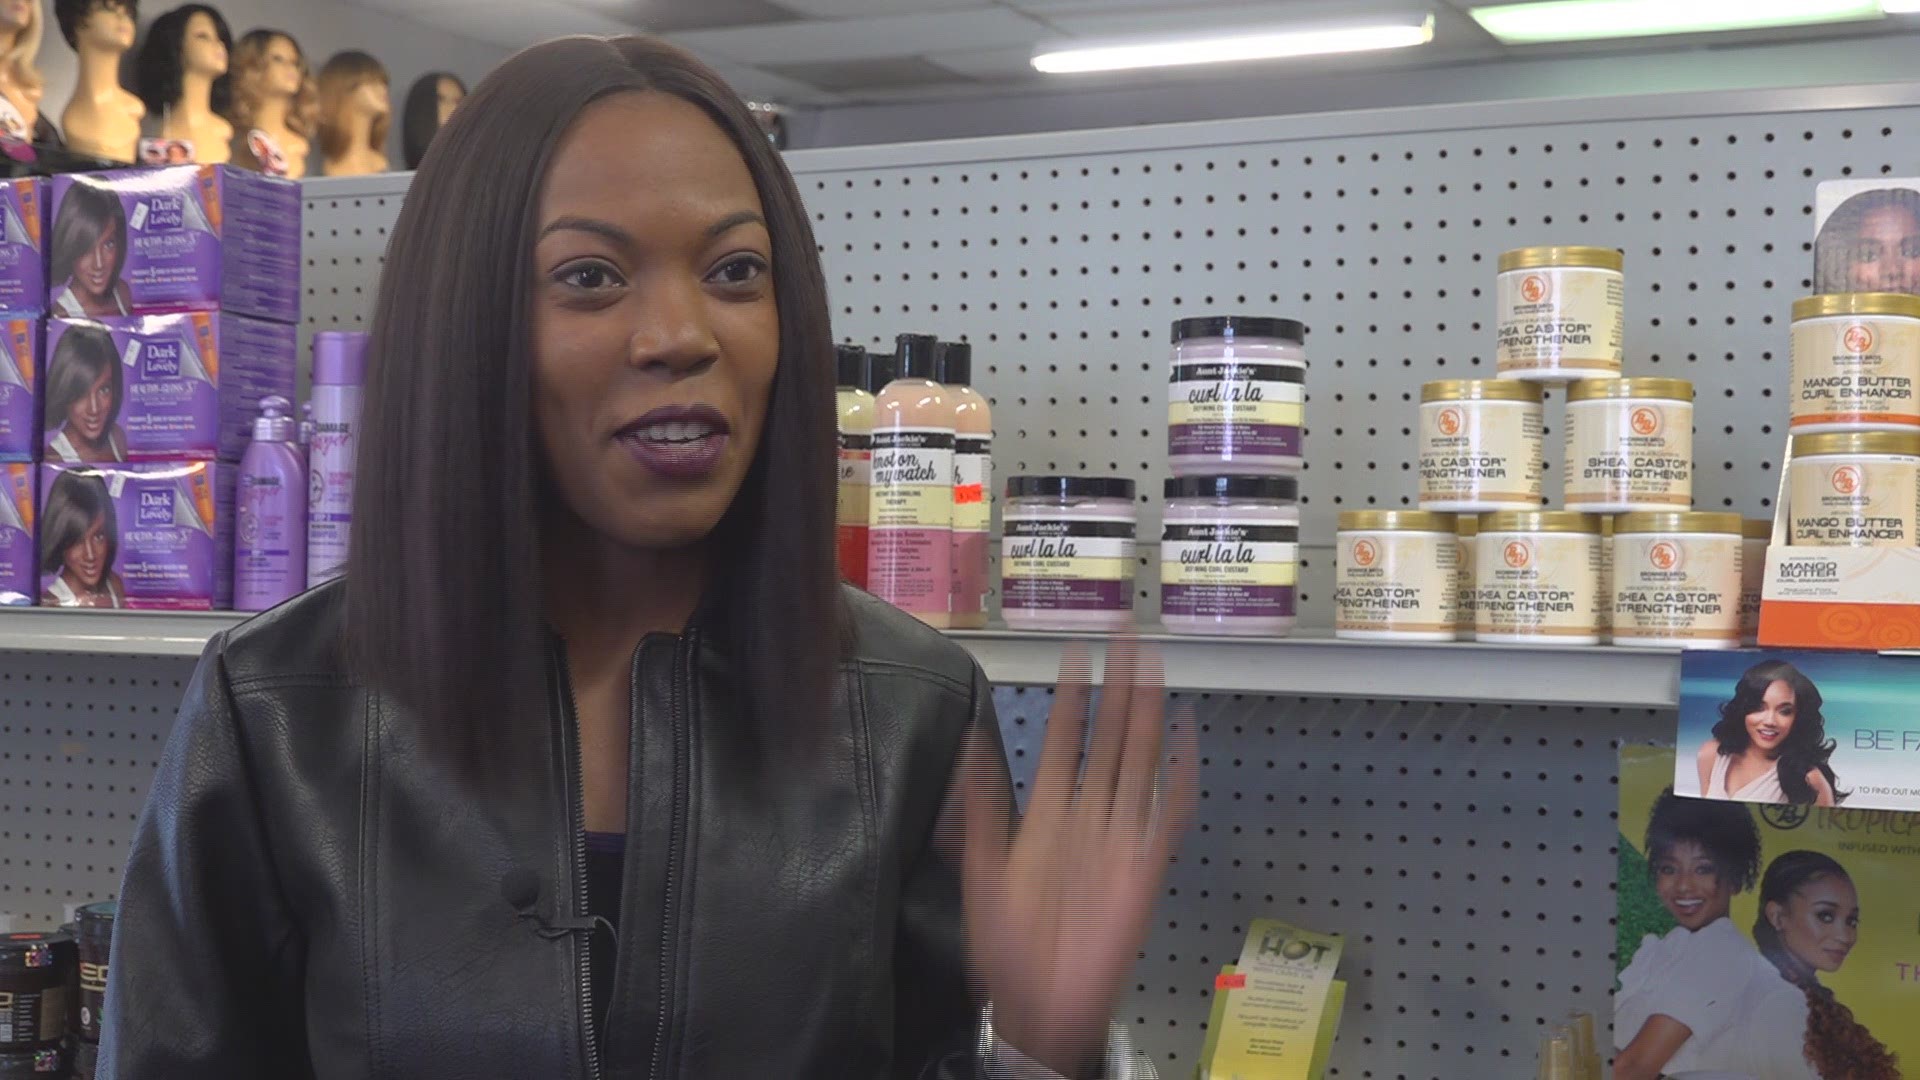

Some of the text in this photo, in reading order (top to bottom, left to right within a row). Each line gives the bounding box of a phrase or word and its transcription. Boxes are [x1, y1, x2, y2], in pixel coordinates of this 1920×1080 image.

[151, 197, 180, 211] Dark
[150, 212, 181, 226] Lovely
[1497, 335, 1591, 349] TRENGTHENER
[147, 344, 176, 359] Dark
[147, 360, 178, 374] Lovely
[1196, 367, 1217, 376] Aunt
[1803, 376, 1911, 388] MANGO BUTTER
[1189, 381, 1264, 404] curl la la
[1802, 388, 1911, 400] CURL ENHANCER
[897, 453, 920, 468] on
[1588, 458, 1627, 468] SHEA
[893, 460, 937, 482] watch
[1584, 468, 1688, 481] STRENGTHENER
[141, 491, 172, 507] Dark
[140, 508, 172, 522] Lovely
[1797, 517, 1902, 528] MANGO BUTTER
[1187, 527, 1249, 537] Aunt Jackie's
[1796, 528, 1904, 539] CURL ENHANCER
[1010, 538, 1078, 559] curl la la
[1180, 543, 1256, 565] curl la la
[1780, 562, 1837, 571] MANGO
[1780, 569, 1837, 578] BUTTER
[1618, 592, 1648, 603] SHEA
[1615, 603, 1722, 615] STRENGTHENER
[1854, 728, 1895, 751] BE
[1859, 785, 1870, 794] TO
[1871, 786, 1890, 795] FIND
[1891, 787, 1908, 796] OUT
[1838, 841, 1888, 853] INFUSED
[1257, 935, 1331, 964] HOT
